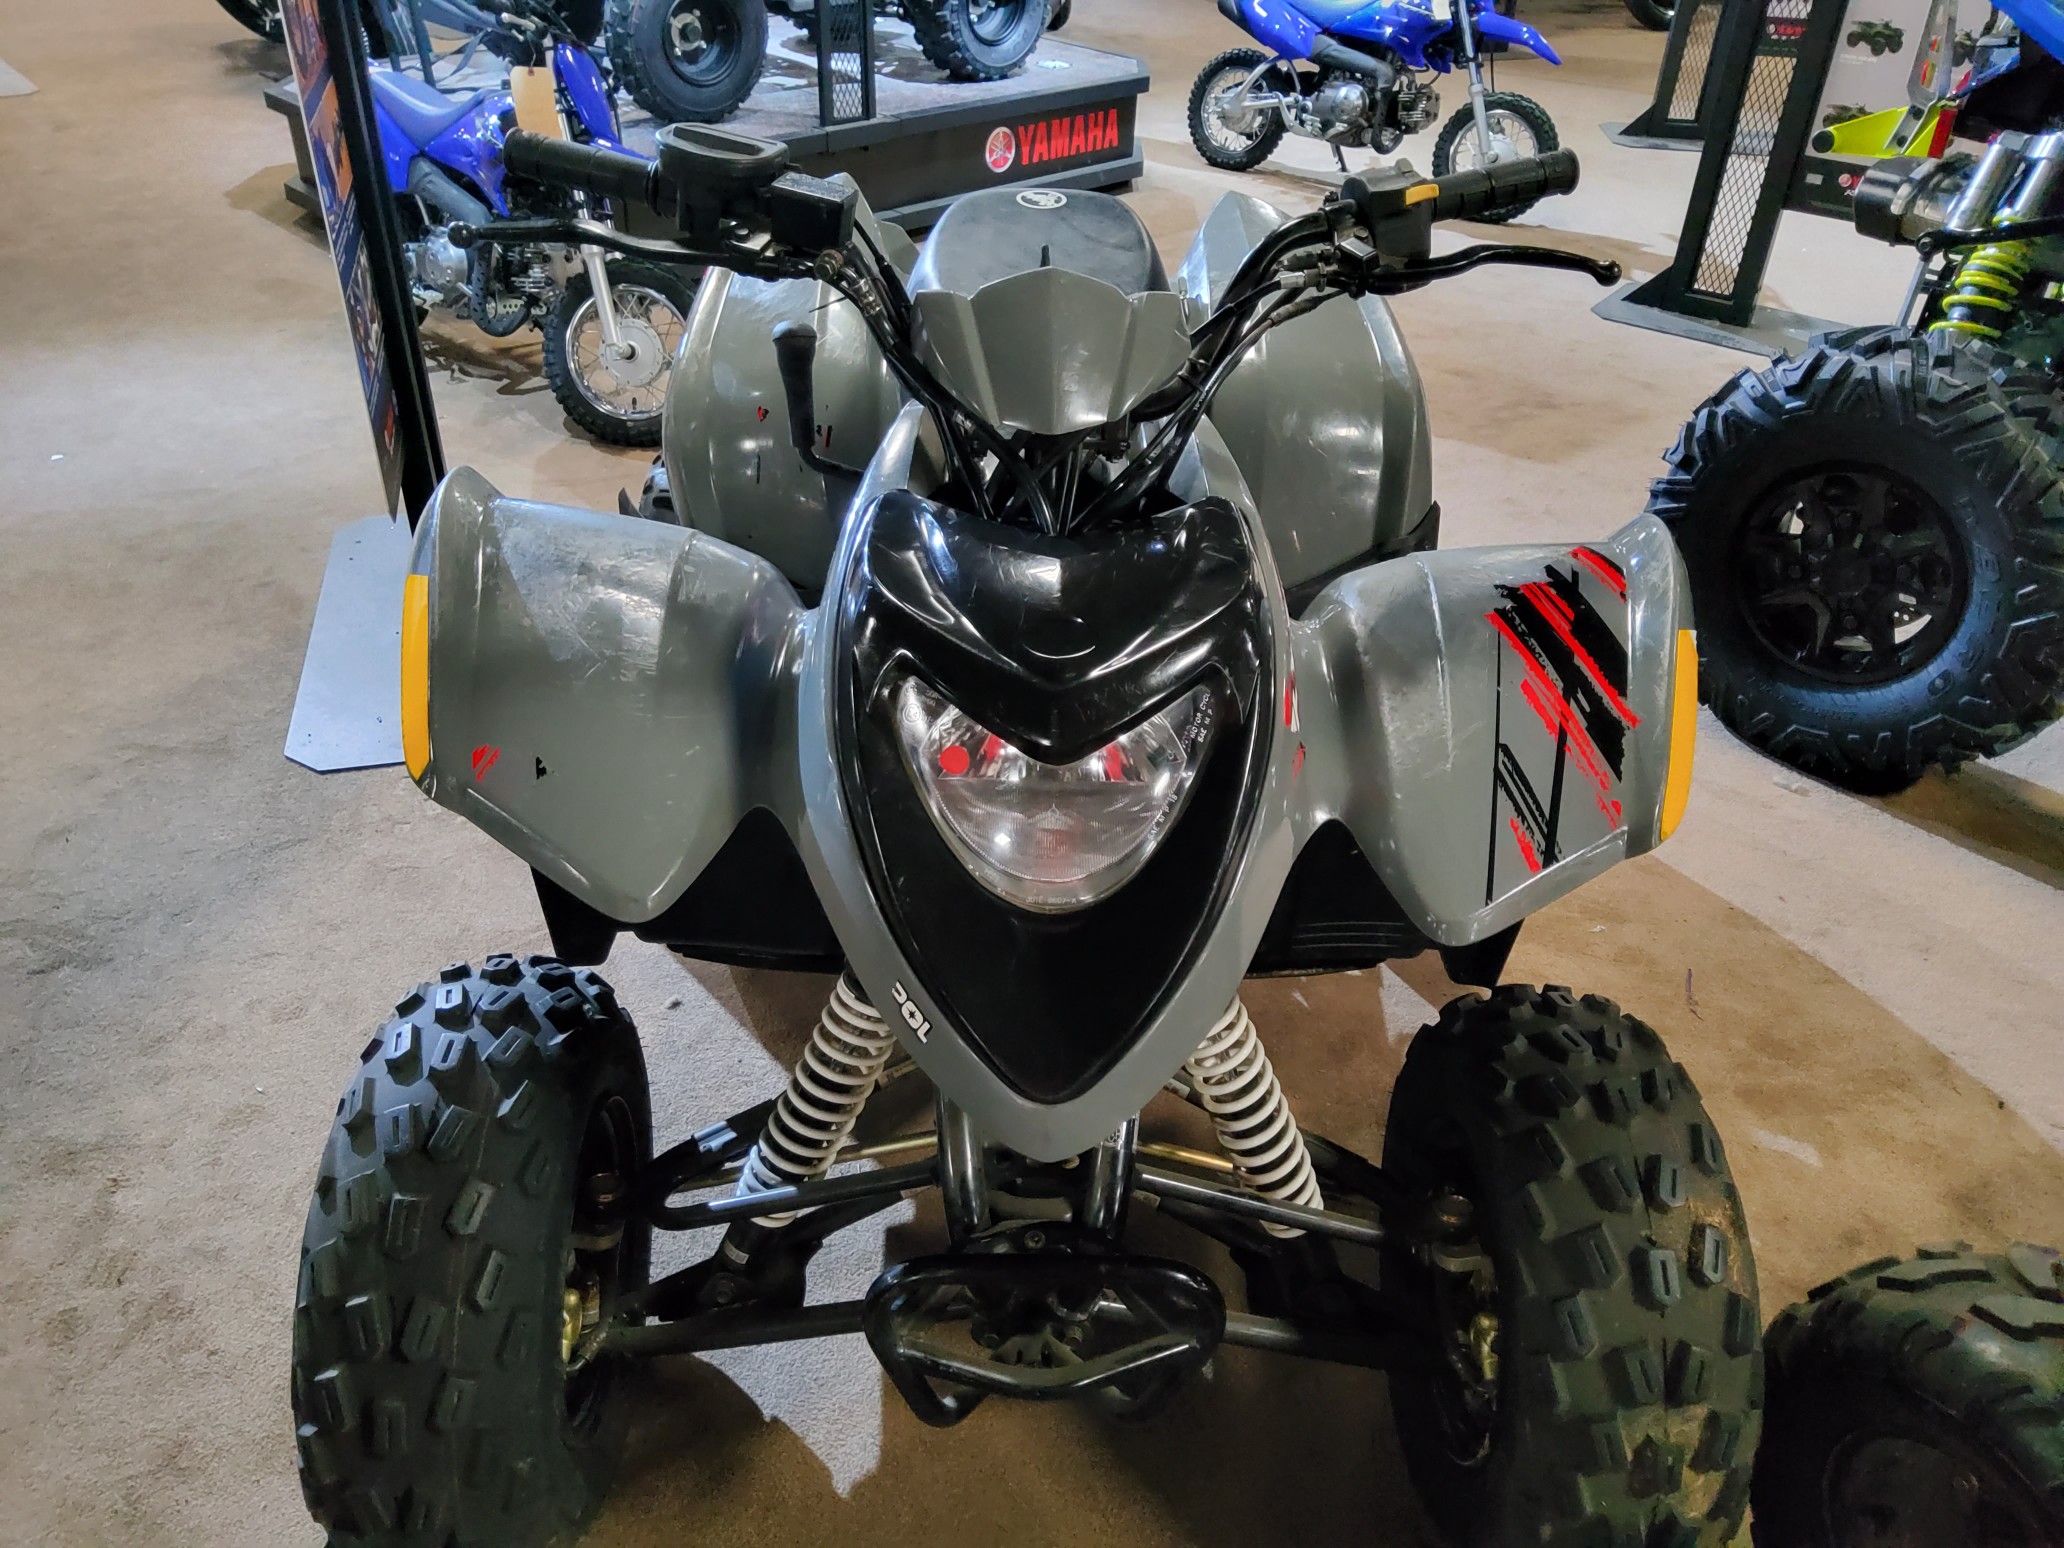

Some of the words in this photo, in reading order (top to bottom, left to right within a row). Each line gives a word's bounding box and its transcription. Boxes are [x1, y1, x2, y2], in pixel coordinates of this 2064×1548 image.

[1017, 108, 1119, 166] YAMAHA
[1189, 712, 1204, 739] MOTOR
[1197, 727, 1208, 743] SAE
